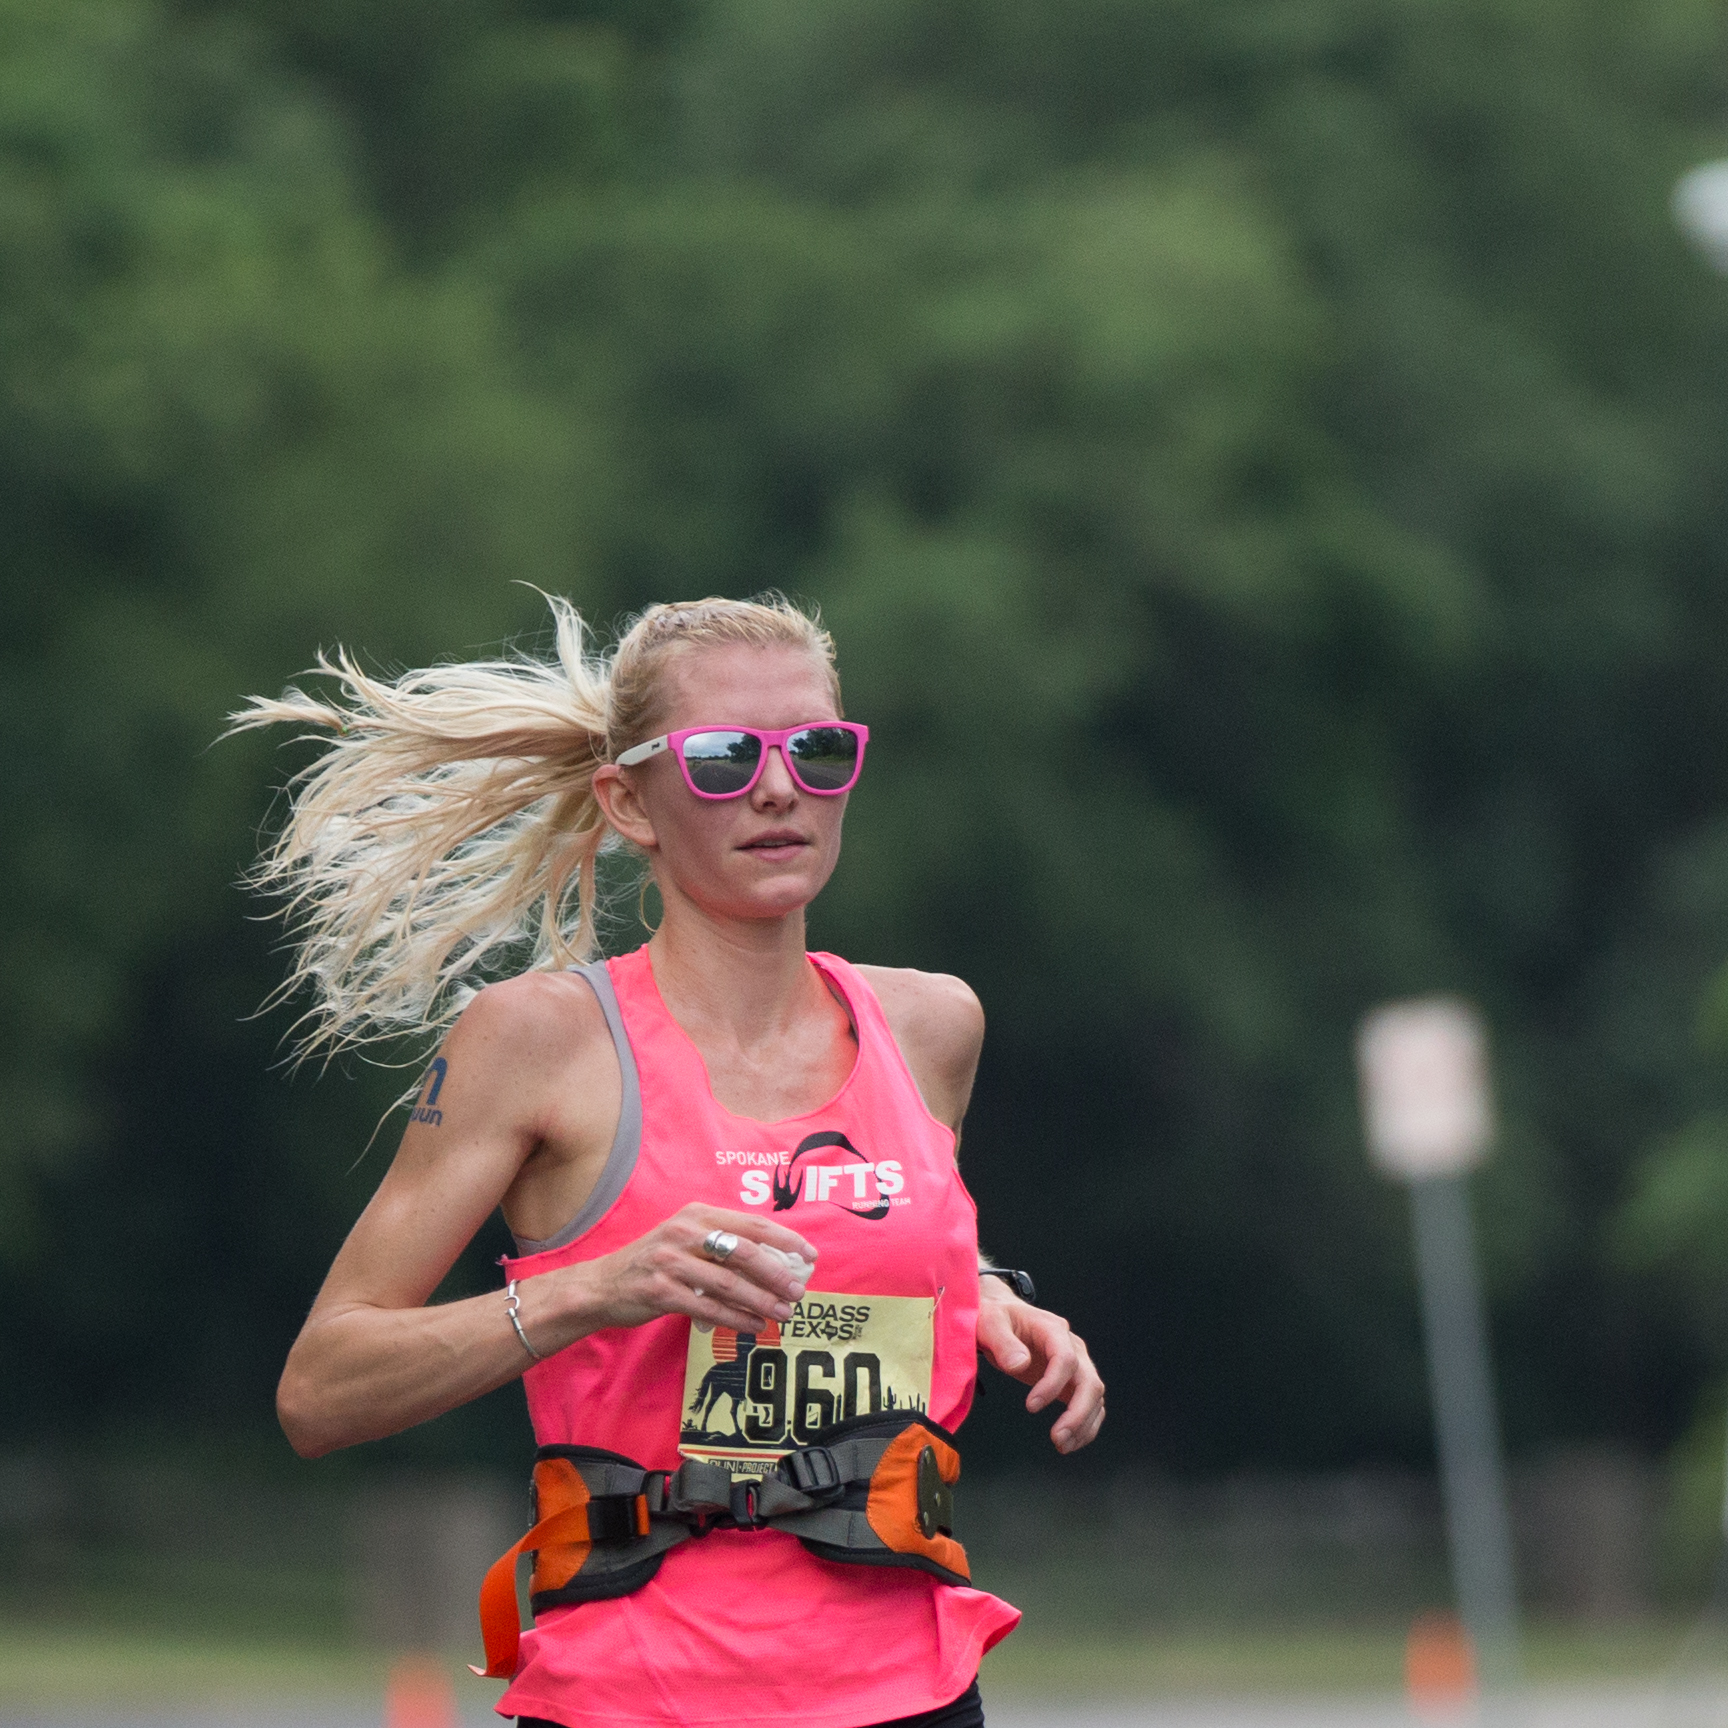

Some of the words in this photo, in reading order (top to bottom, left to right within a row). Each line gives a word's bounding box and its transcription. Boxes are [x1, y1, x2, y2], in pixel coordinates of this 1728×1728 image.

[715, 1151, 791, 1166] SPOKANE
[740, 1160, 904, 1211] SWIFTS
[791, 1302, 871, 1322] ADASS
[743, 1347, 881, 1444] 960
